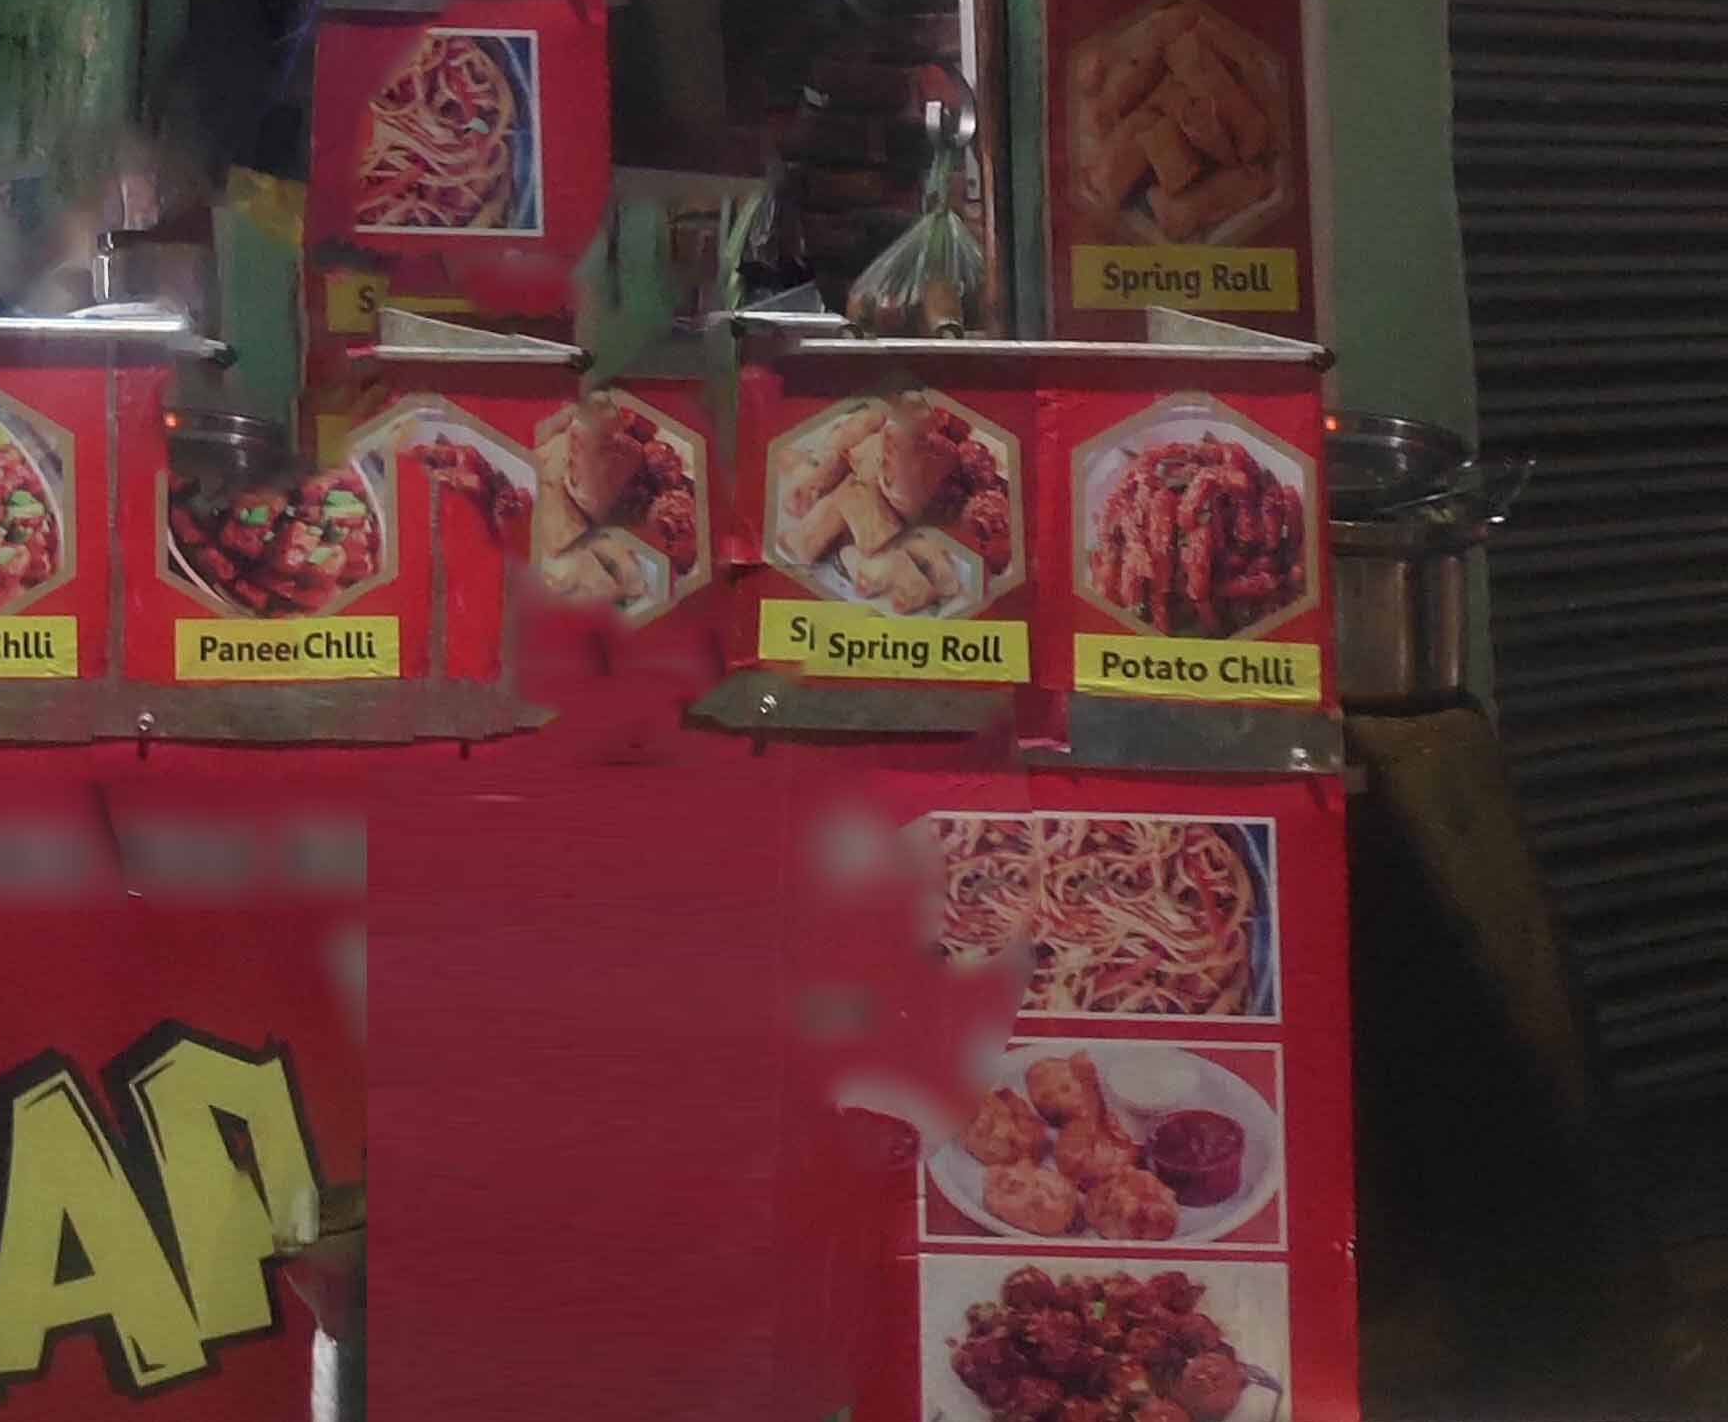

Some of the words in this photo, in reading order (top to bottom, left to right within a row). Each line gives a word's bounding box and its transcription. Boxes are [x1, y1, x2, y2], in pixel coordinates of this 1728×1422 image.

[1103, 260, 1201, 299] Spring
[1211, 261, 1271, 292] Roll
[828, 632, 930, 669] Spring
[941, 635, 1004, 663] Roll
[1101, 650, 1208, 683] Potato
